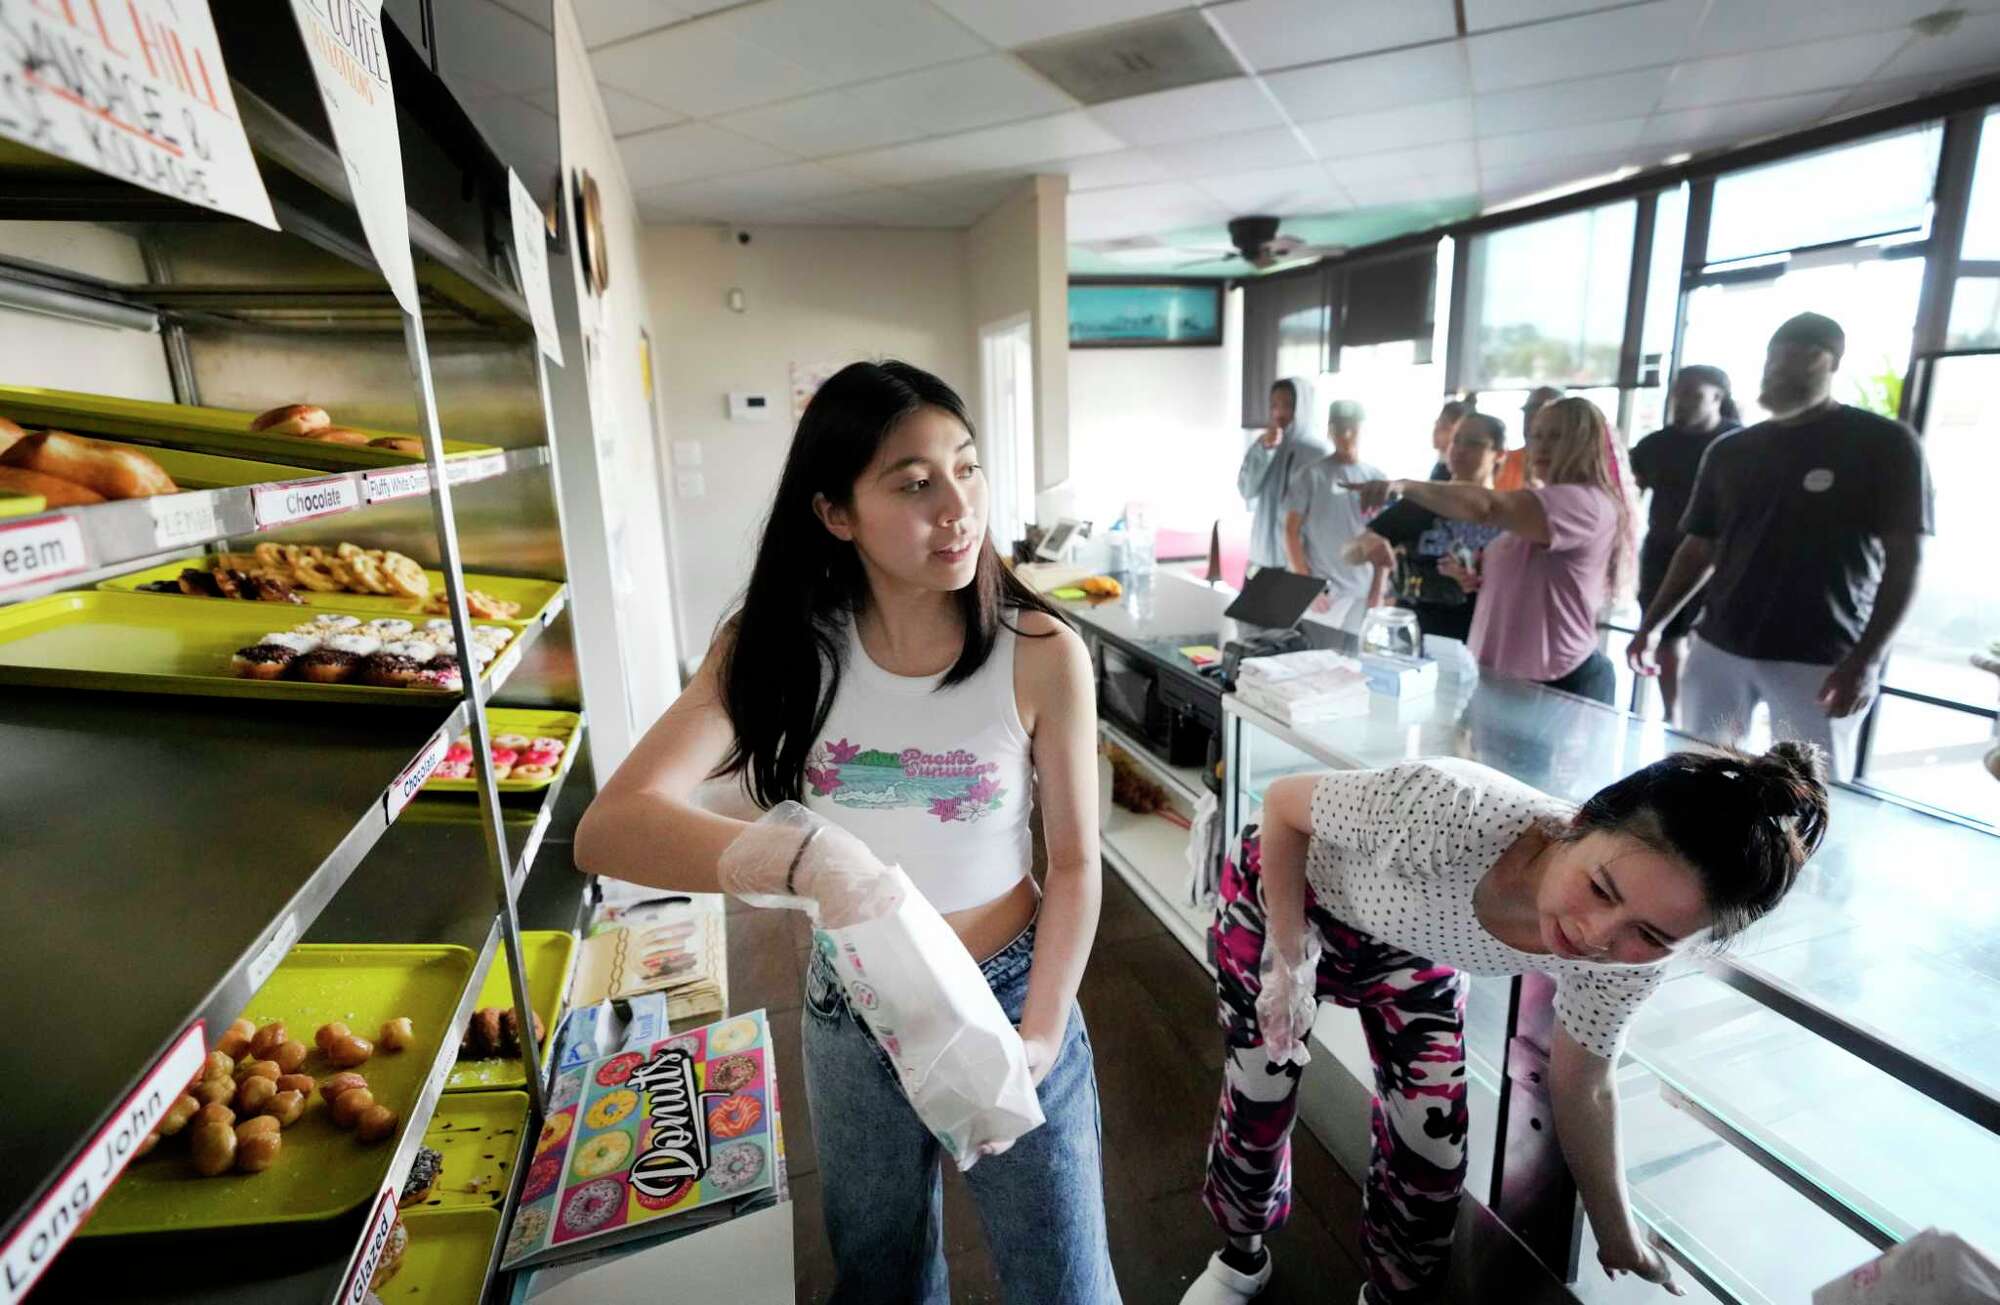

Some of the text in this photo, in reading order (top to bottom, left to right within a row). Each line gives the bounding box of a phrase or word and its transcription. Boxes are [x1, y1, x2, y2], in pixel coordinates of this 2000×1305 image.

[286, 488, 342, 514] Chocolate
[2, 538, 66, 574] eam
[403, 753, 437, 798] Chocolate
[900, 748, 977, 767] Pacific
[626, 1050, 710, 1198] Donuts
[5, 1090, 163, 1292] Long John
[353, 1212, 389, 1304] Glazed
